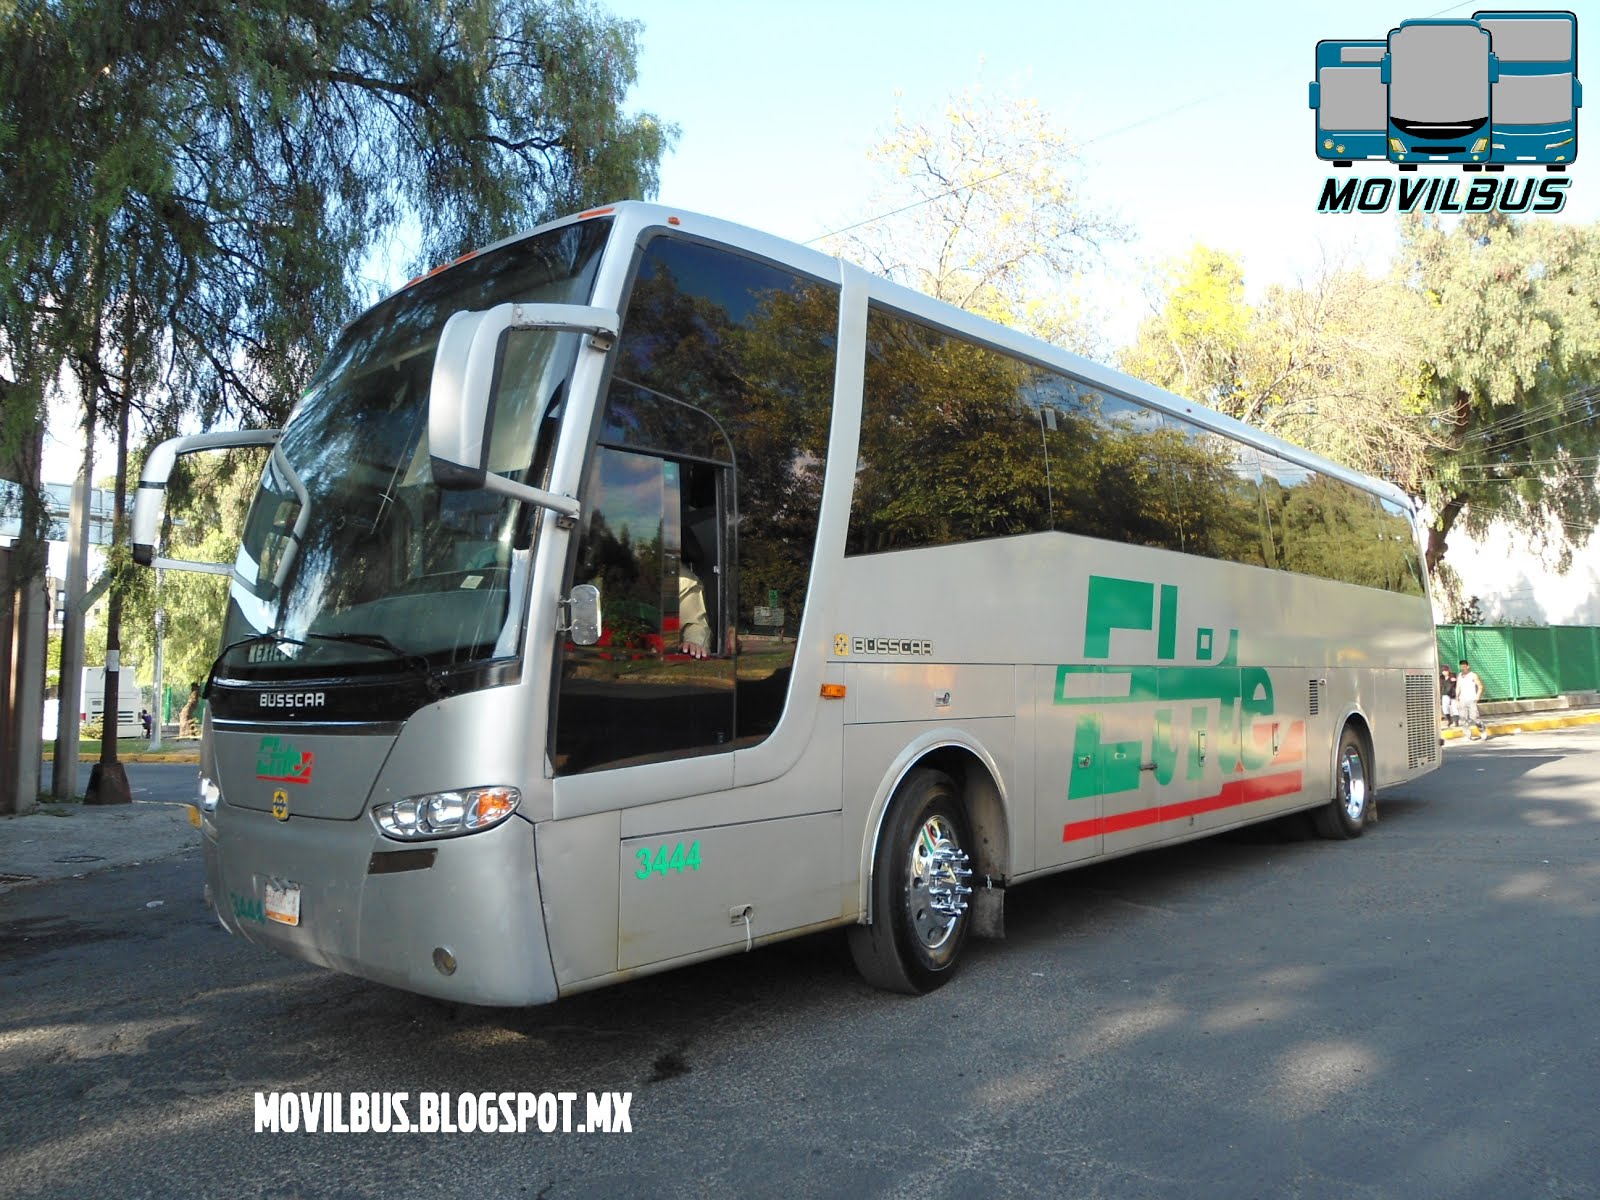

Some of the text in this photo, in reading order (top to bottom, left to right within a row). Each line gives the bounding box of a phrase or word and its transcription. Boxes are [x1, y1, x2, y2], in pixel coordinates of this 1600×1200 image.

[852, 637, 933, 656] BUSSCAR
[259, 692, 325, 707] BUSSCAR
[635, 839, 702, 880] 3444
